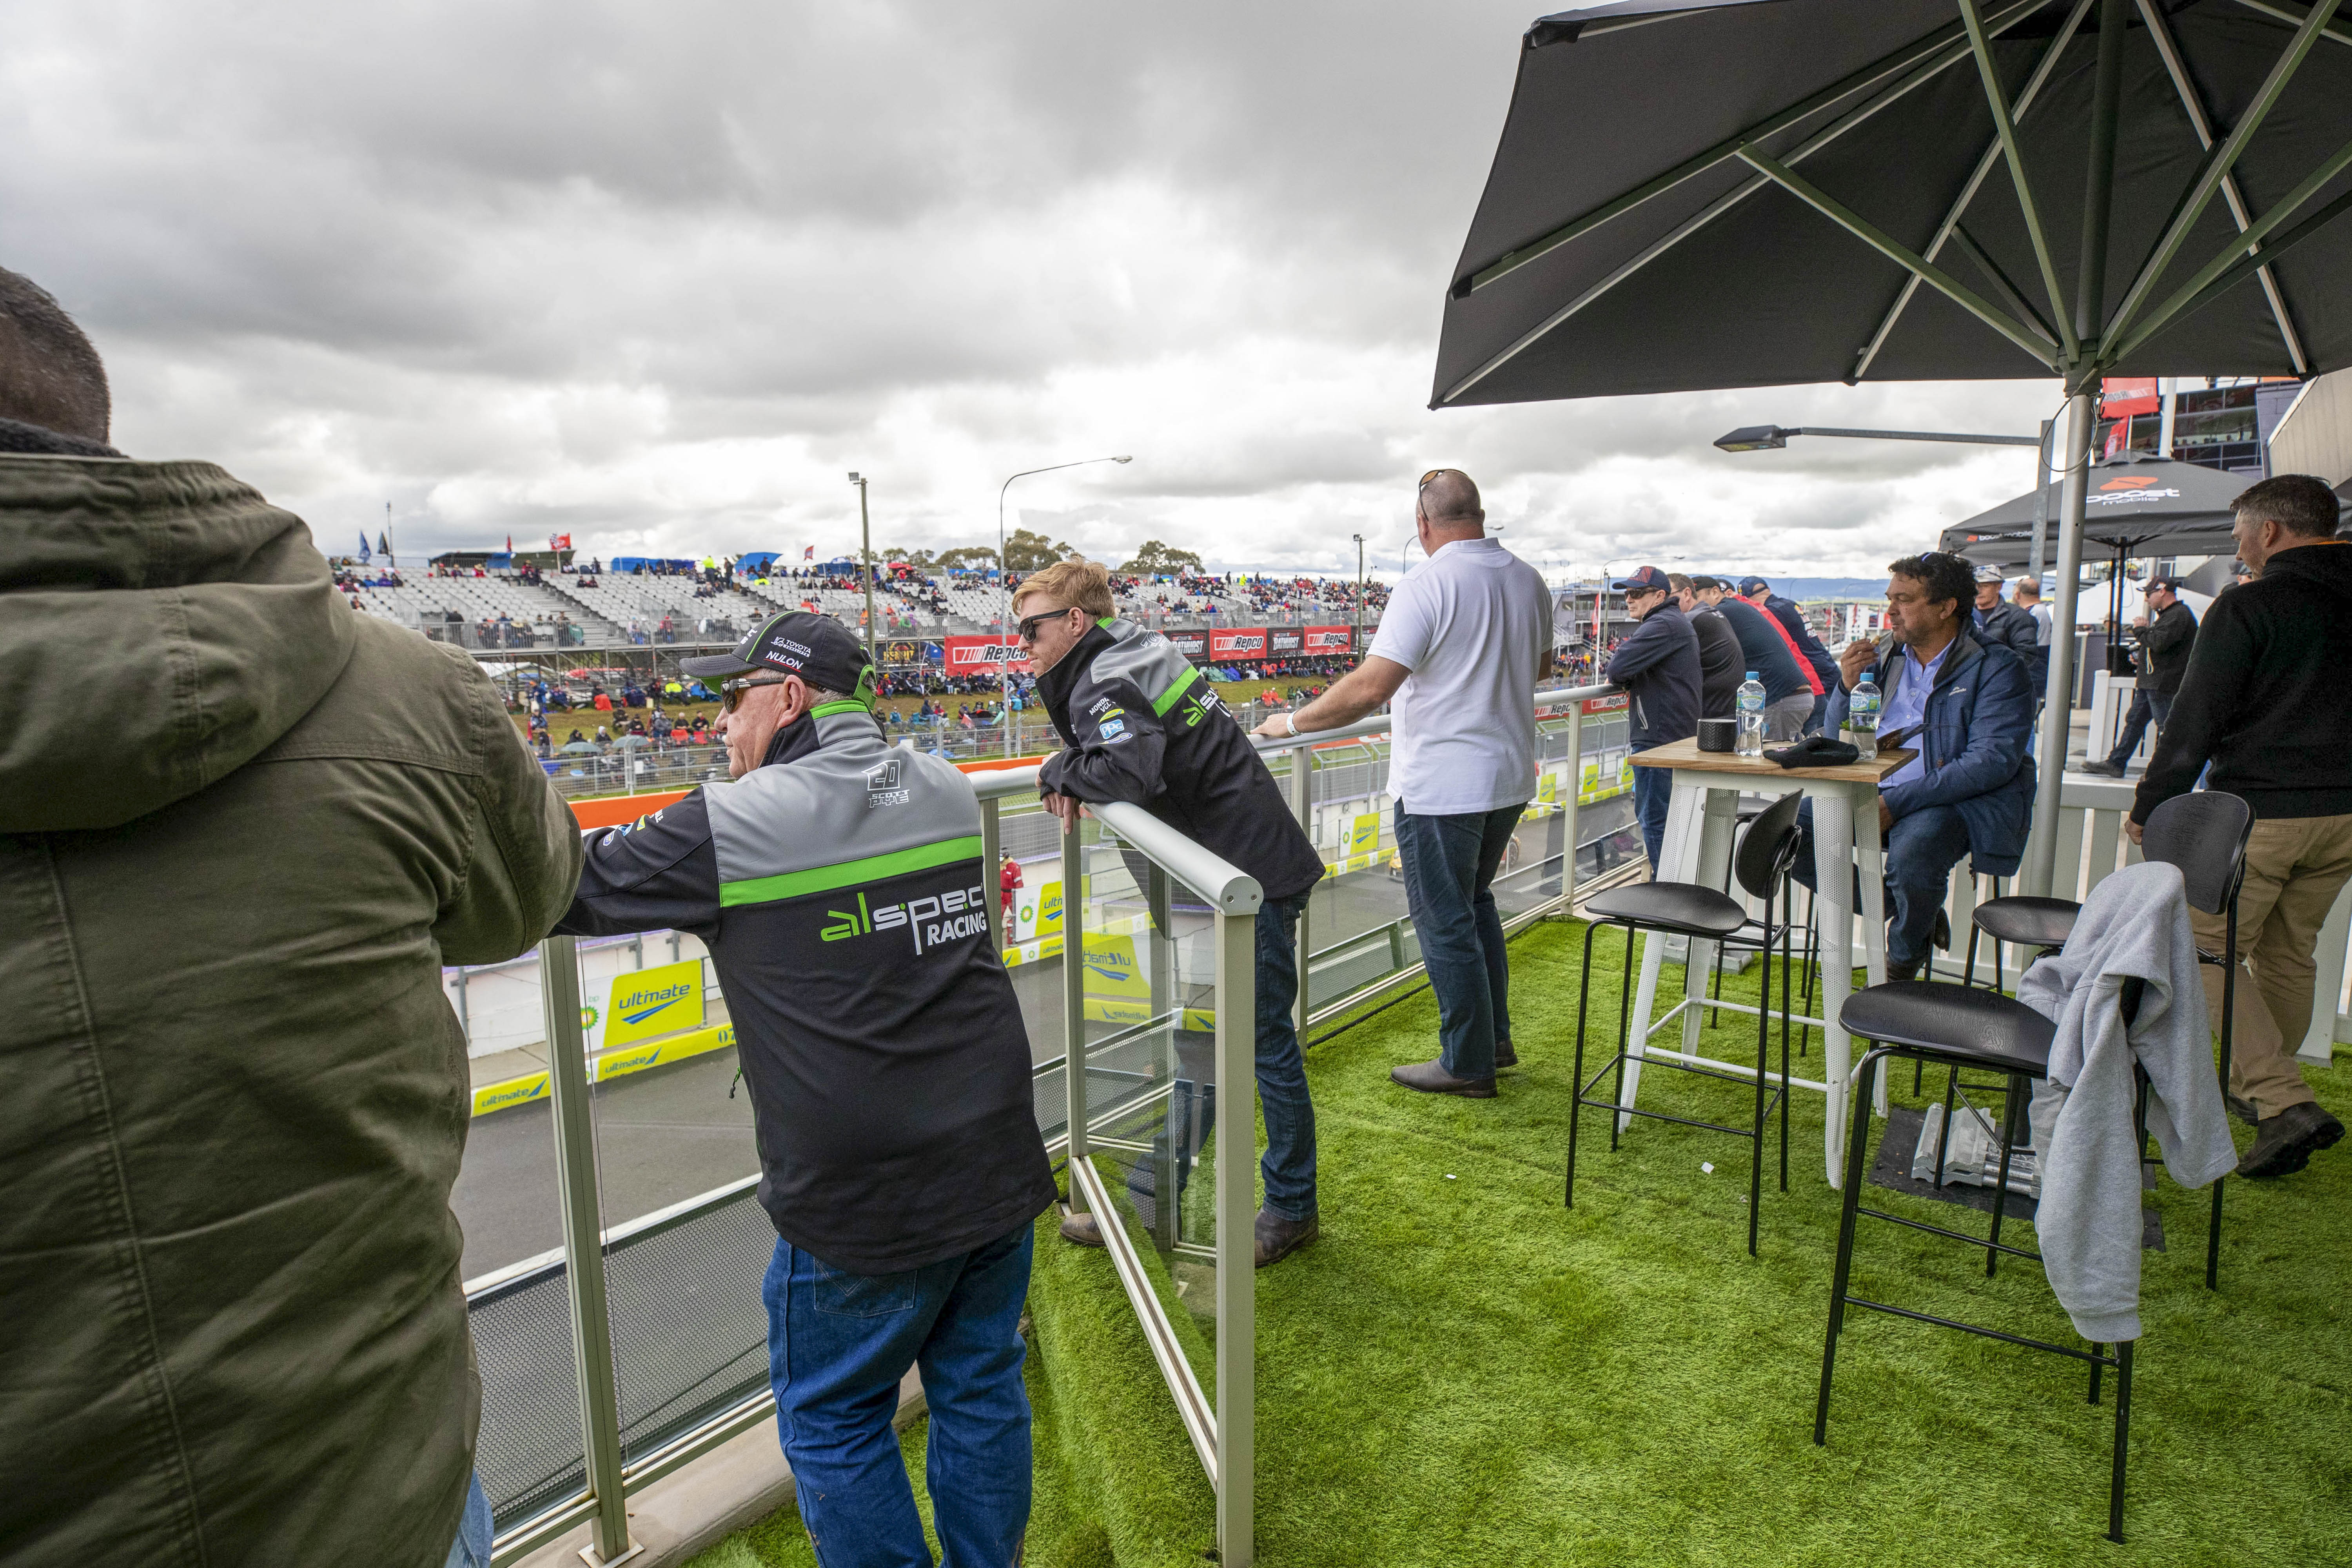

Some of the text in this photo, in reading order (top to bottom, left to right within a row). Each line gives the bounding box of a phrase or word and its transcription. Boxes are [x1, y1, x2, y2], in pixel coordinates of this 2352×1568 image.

[2102, 497, 2159, 506] mobile
[786, 639, 811, 654] TOYOTA
[1234, 636, 1263, 651] Repco
[1273, 637, 1299, 651] BATHURST
[765, 651, 804, 670] NULON
[1607, 696, 1628, 707] Repco
[1551, 704, 1570, 715] Repc
[1102, 723, 1123, 736] PPG
[861, 760, 900, 791] 20
[871, 789, 910, 799] SCOTT
[869, 795, 909, 808] PYE
[1355, 824, 1376, 835] ultimate
[1044, 895, 1062, 909] ultim
[927, 911, 987, 946] RACING
[619, 984, 690, 1009] ultimate
[605, 1056, 646, 1074] ultimate
[482, 1087, 530, 1107] ultimate
